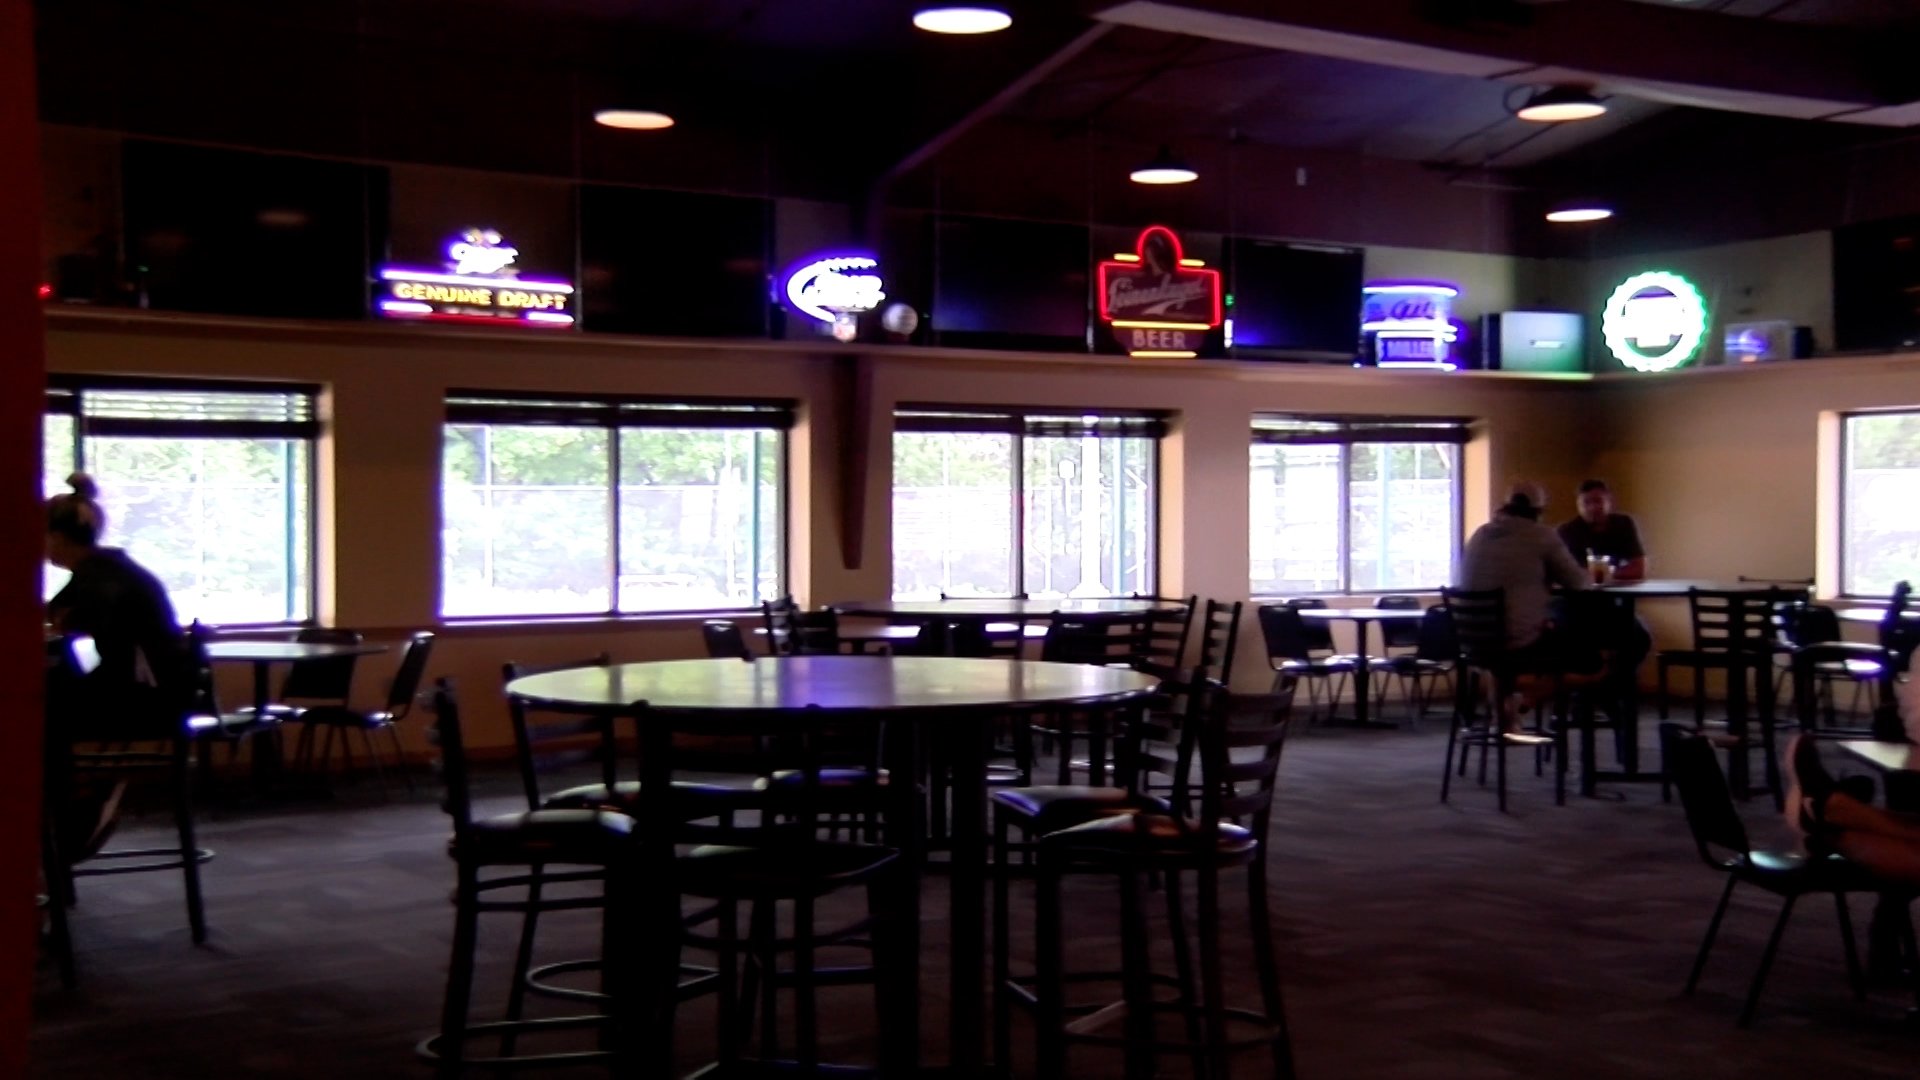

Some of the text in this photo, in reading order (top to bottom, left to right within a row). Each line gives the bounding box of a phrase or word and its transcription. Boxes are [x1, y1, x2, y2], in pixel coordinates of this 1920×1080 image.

[394, 282, 567, 309] GENUINE DRAFT
[1132, 328, 1186, 349] BEER
